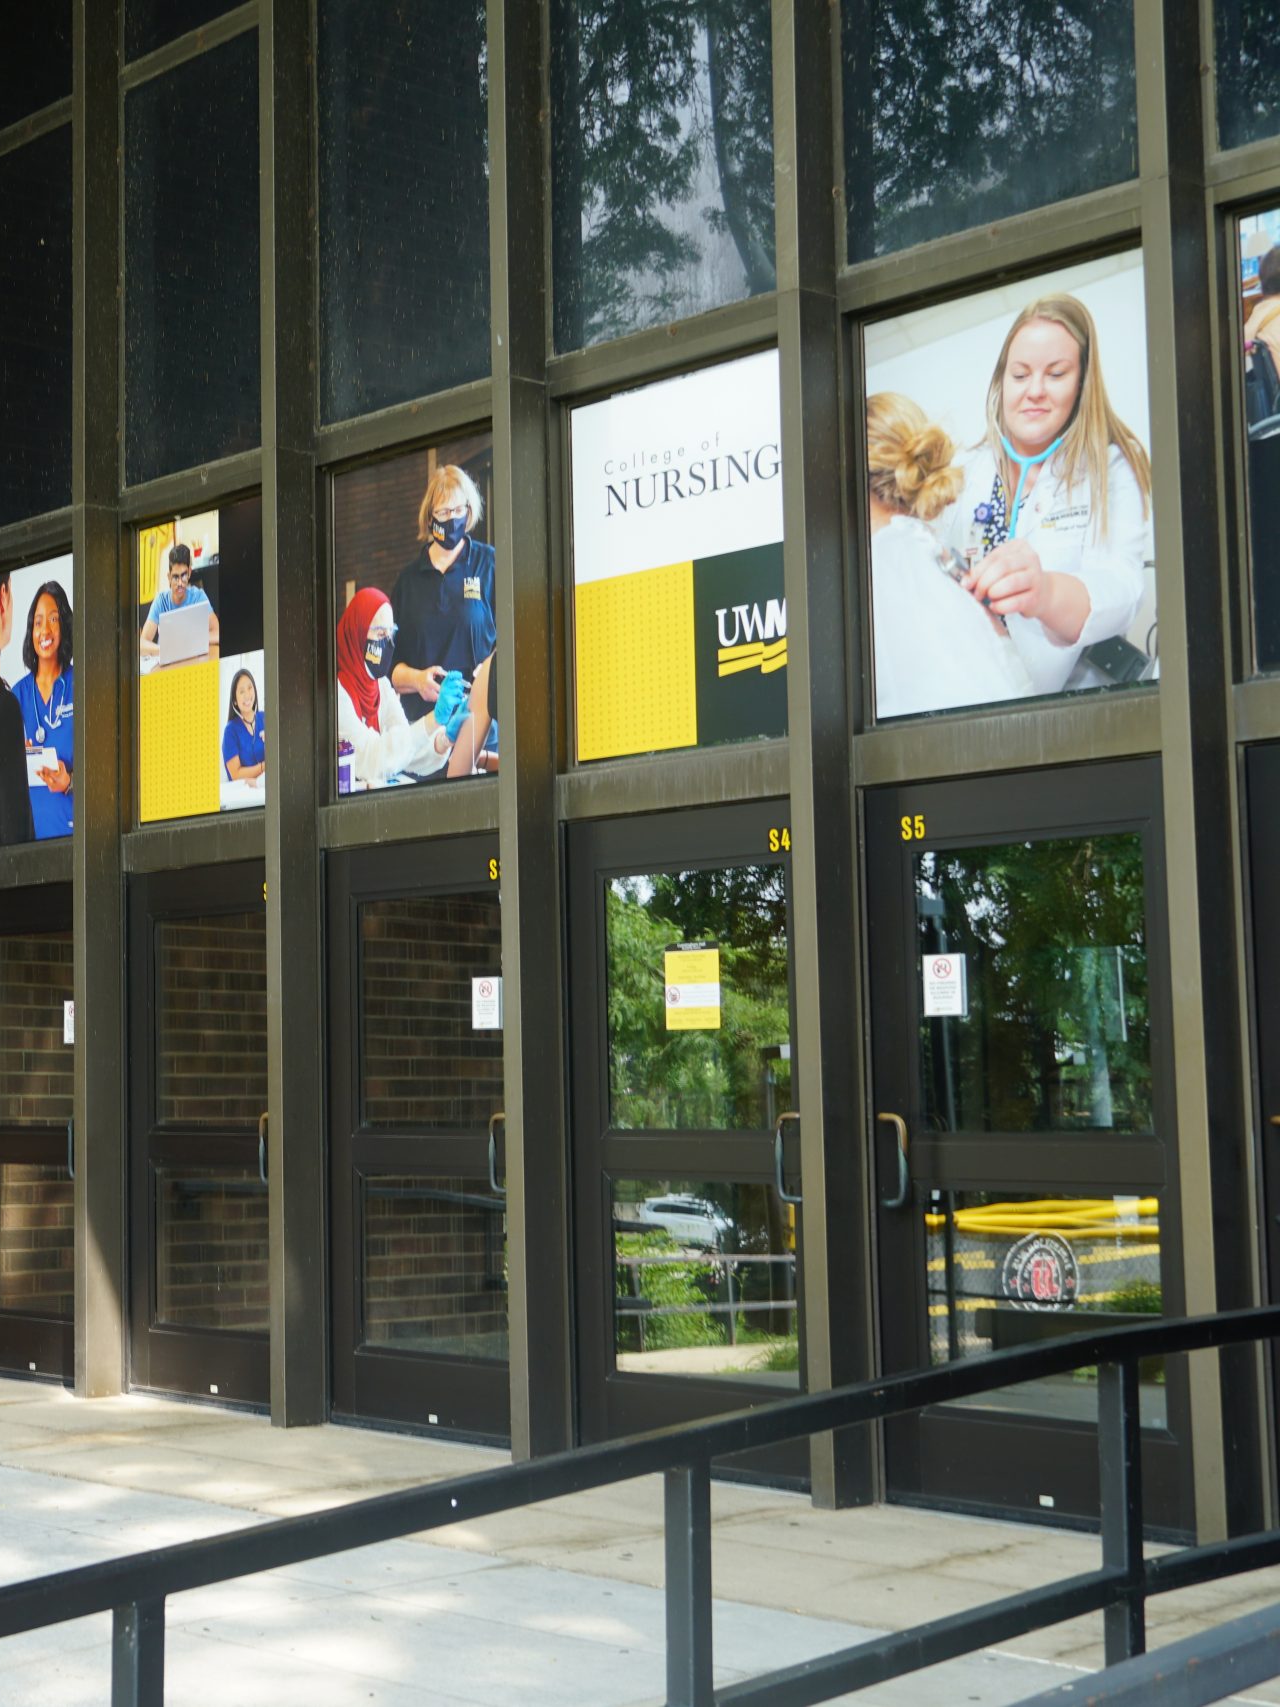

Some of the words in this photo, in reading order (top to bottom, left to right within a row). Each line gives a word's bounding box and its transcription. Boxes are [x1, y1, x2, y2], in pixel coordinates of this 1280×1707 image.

[604, 447, 685, 475] College
[701, 431, 720, 451] of
[605, 444, 782, 517] NURSING
[769, 828, 791, 852] S4
[901, 815, 925, 841] S5
